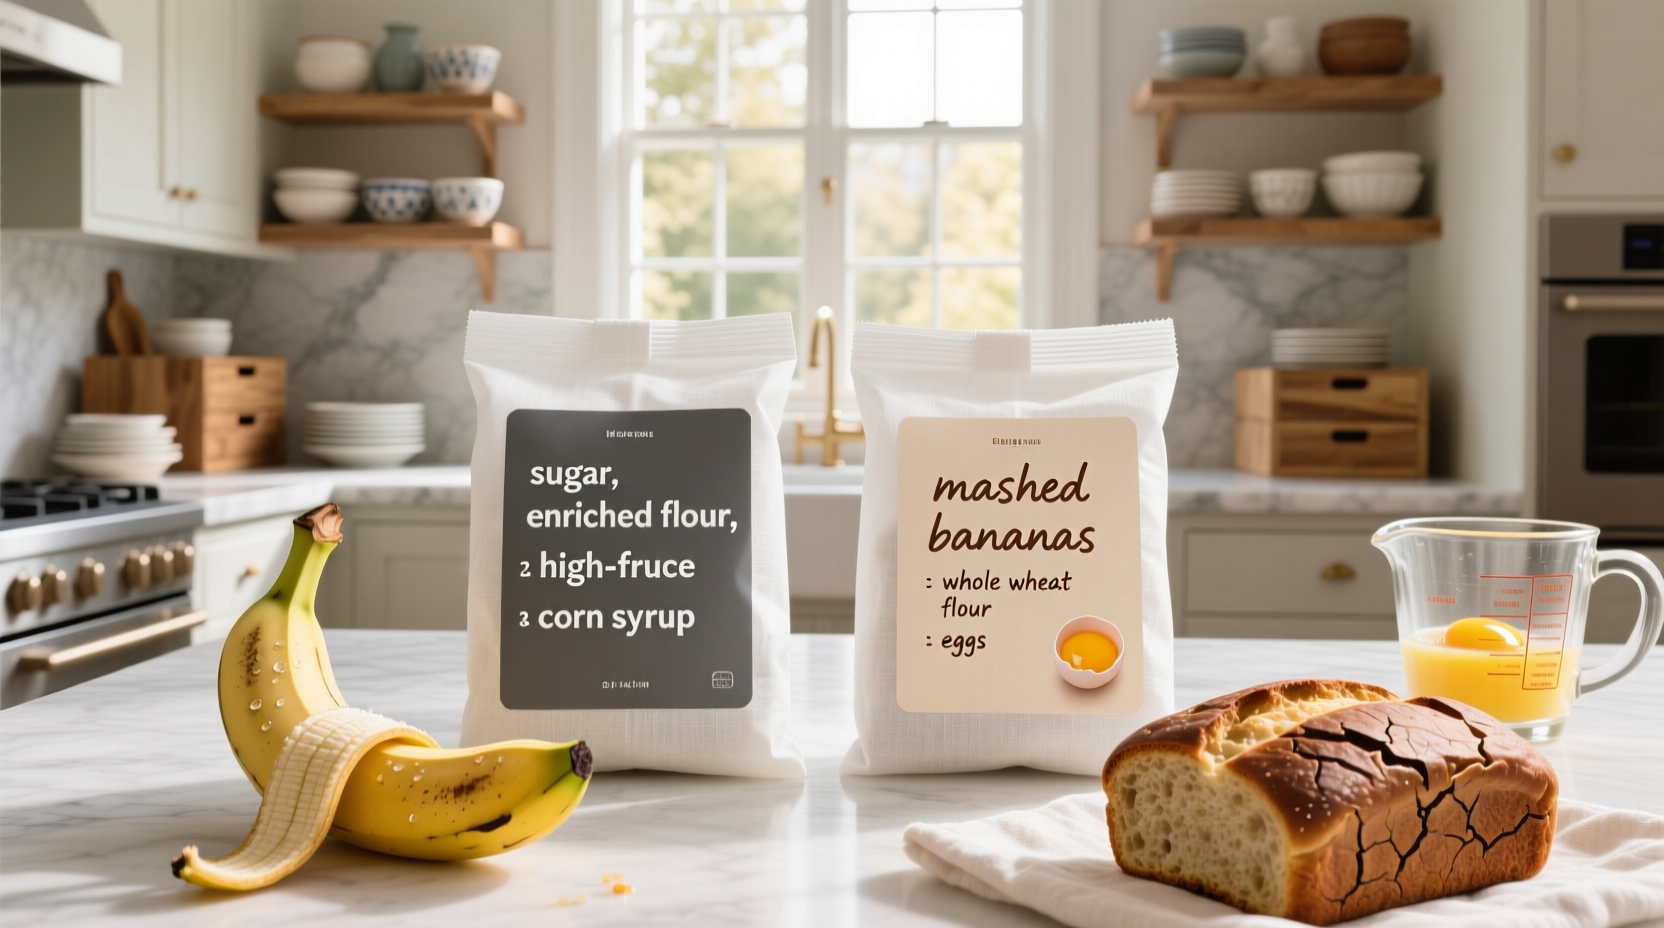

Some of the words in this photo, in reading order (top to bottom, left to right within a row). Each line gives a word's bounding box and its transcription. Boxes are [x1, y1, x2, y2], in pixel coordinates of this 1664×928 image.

[529, 465, 619, 493] sugar,
[932, 461, 1090, 504] mashed
[526, 500, 652, 528] enriched
[660, 500, 738, 533] flour,
[928, 511, 1096, 553] bananas
[540, 550, 696, 587] high-fruce
[942, 569, 1001, 591] whole
[1008, 569, 1073, 591] wheat
[940, 596, 992, 618] flour
[538, 609, 604, 629] corn
[611, 609, 696, 637] syrup
[941, 634, 987, 657] eggs
